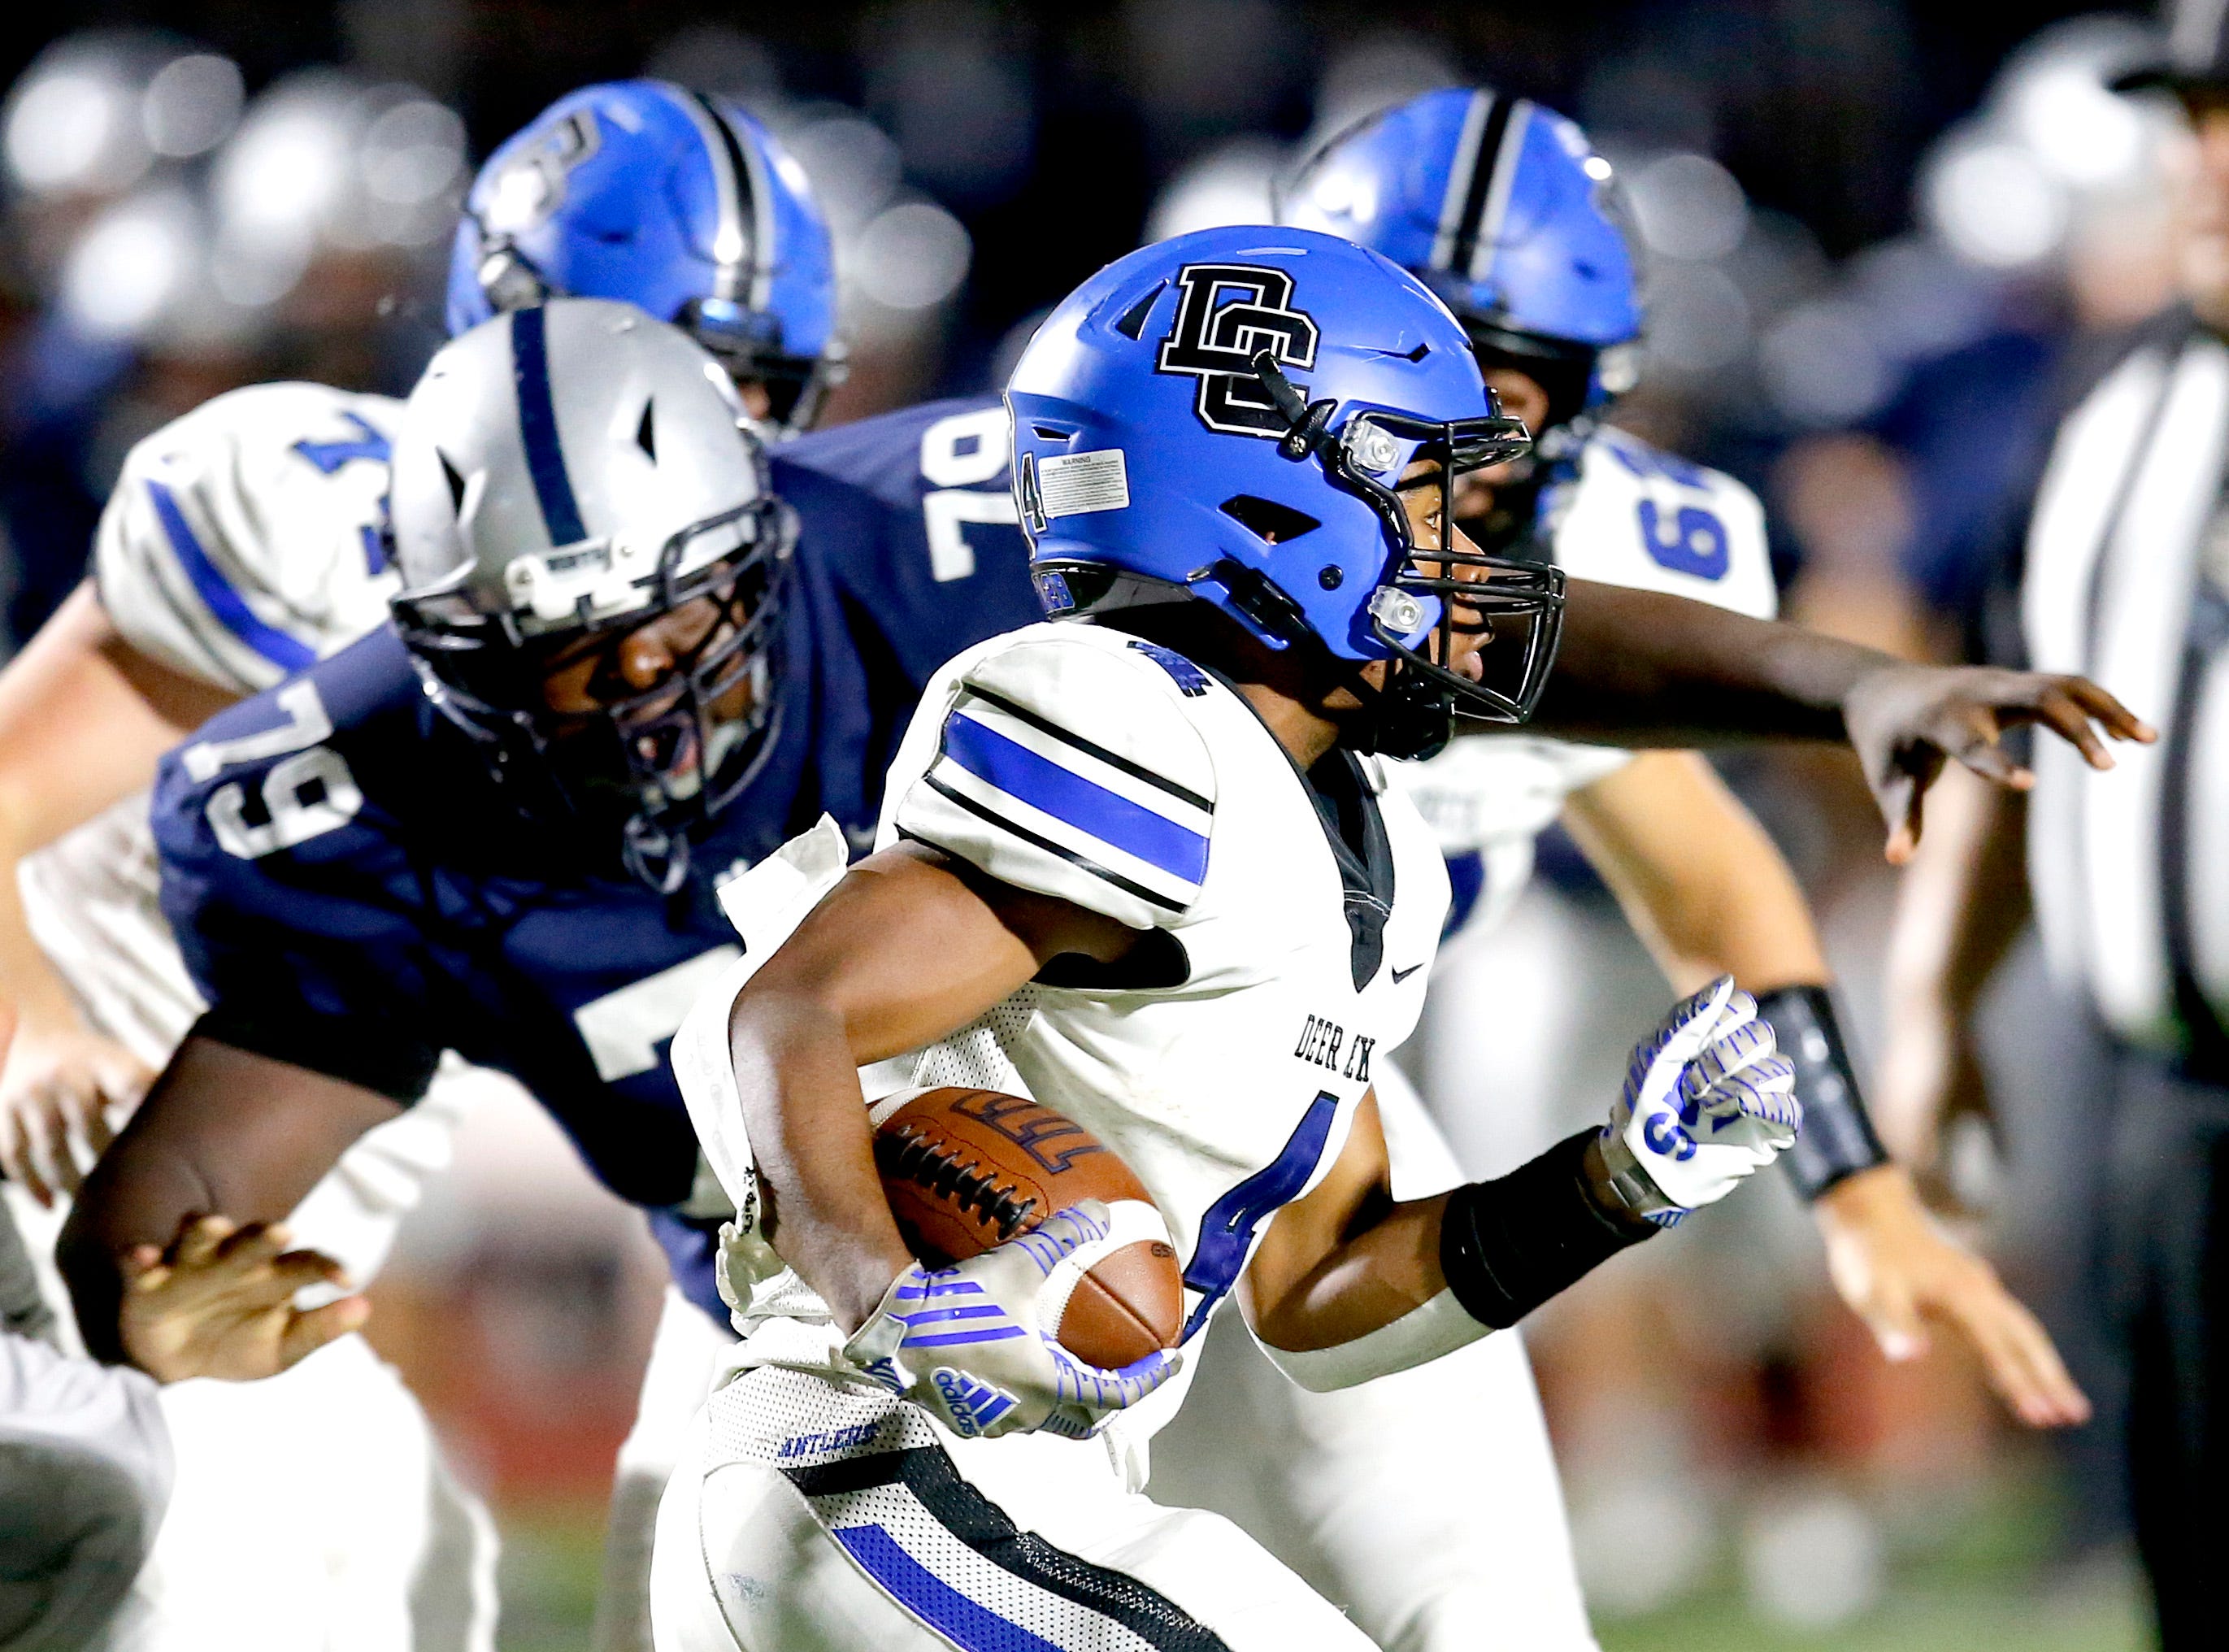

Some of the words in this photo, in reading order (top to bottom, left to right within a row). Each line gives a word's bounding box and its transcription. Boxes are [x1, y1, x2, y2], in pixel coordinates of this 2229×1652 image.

[1062, 455, 1091, 466] WARNING
[1021, 452, 1047, 533] 4
[180, 678, 364, 860] 79
[1294, 1014, 1343, 1072] DEER
[936, 1372, 979, 1436] adidas
[777, 1422, 881, 1458] ANTLERS
